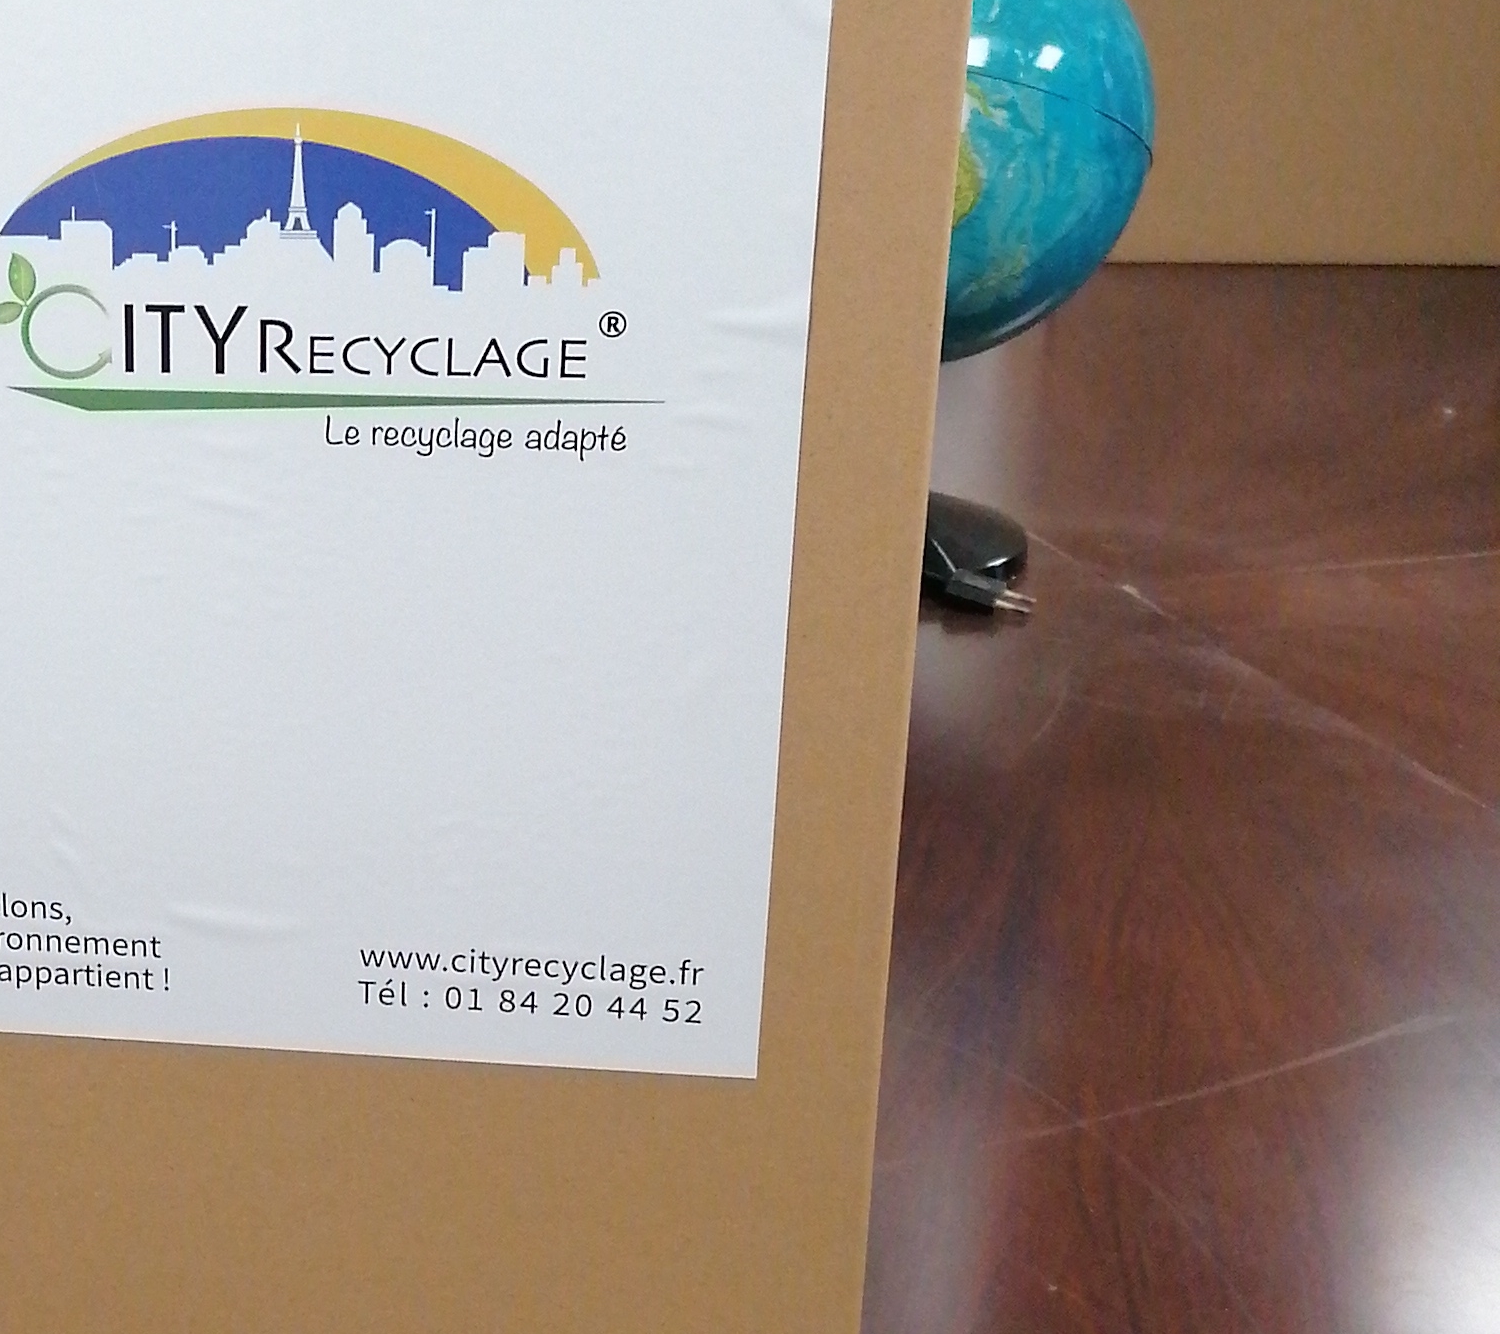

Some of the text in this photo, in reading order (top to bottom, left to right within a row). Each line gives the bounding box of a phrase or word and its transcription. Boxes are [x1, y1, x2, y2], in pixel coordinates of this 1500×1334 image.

[325, 414, 628, 462] Le recyclage adapté
[360, 948, 705, 991] www.cityrecyclage.fr
[357, 978, 407, 1007] Tél
[445, 986, 483, 1011] 01
[498, 989, 538, 1015] 84
[552, 992, 592, 1018] 20
[606, 996, 648, 1021] 44
[662, 998, 702, 1024] 52
